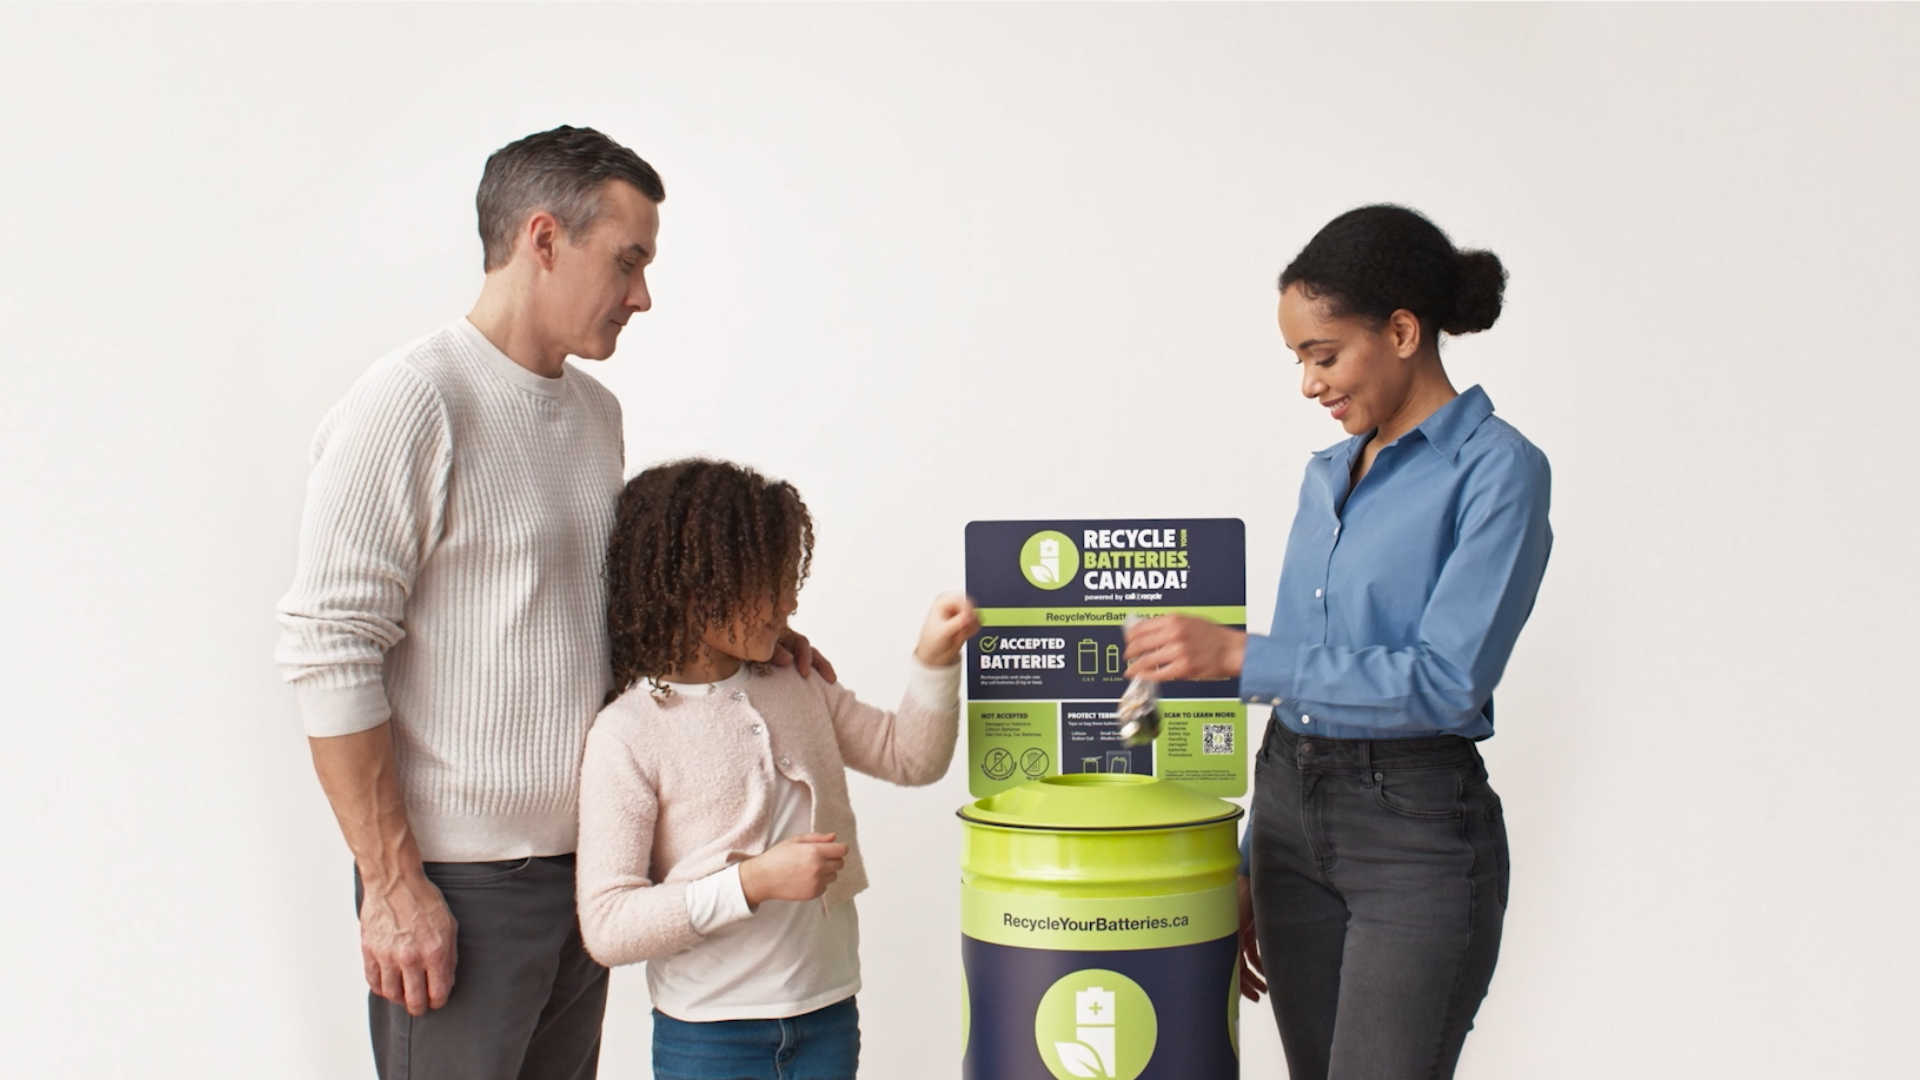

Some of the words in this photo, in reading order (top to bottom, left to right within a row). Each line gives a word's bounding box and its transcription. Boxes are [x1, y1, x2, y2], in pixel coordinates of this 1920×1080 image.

[1084, 529, 1175, 548] RECYCLE
[1180, 529, 1188, 548] YOUR
[1084, 571, 1187, 590] CANADA!
[999, 638, 1066, 650] ACCEPTED
[980, 654, 1066, 669] BATTERIES
[1004, 913, 1189, 932] RecycleYourBatteries.ca
